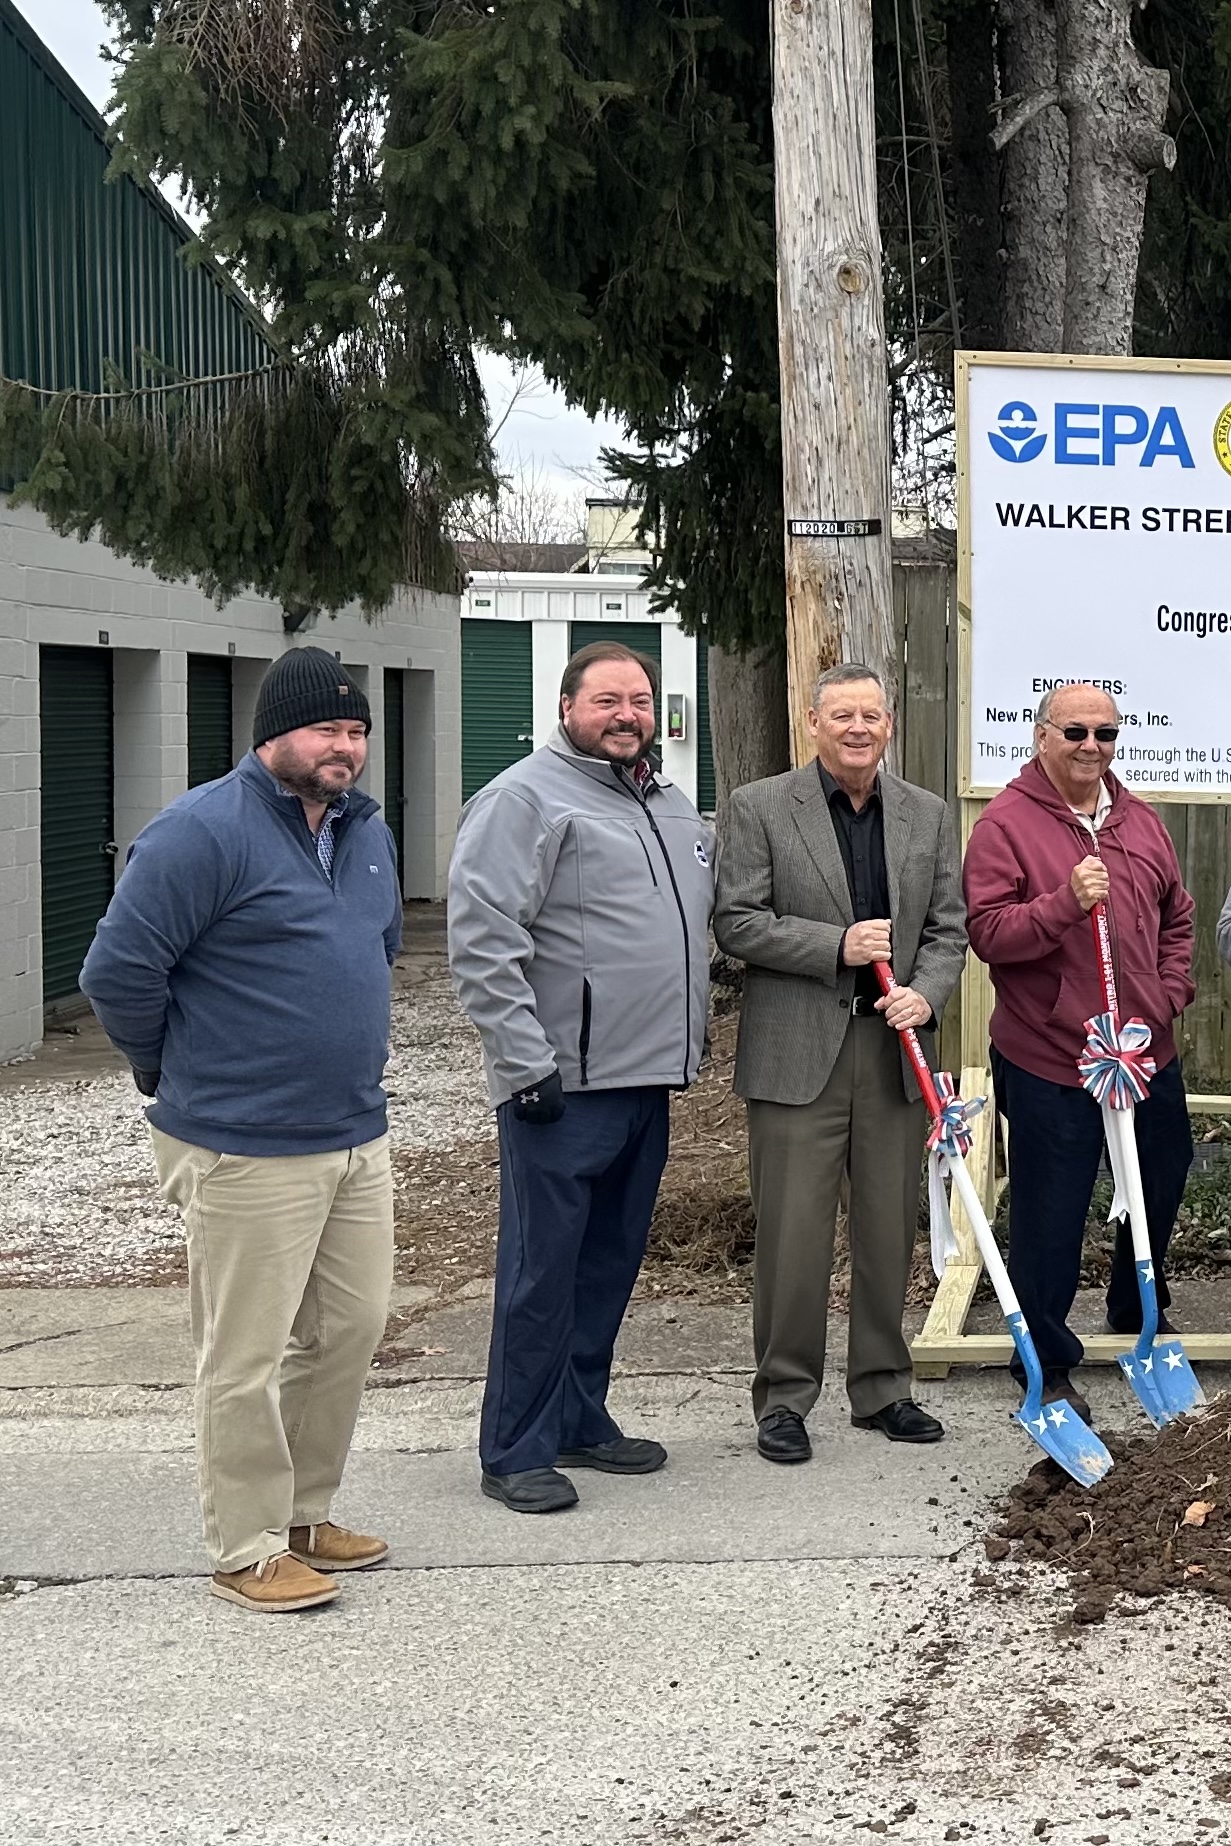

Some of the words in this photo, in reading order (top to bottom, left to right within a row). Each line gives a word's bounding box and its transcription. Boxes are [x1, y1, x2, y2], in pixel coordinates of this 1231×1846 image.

[1054, 403, 1195, 468] EPA
[996, 503, 1130, 530] WALKER
[987, 708, 1018, 722] New
[1147, 711, 1173, 726] Inc.
[977, 742, 1006, 757] This
[1129, 746, 1180, 764] through
[1186, 747, 1206, 762] the
[1126, 768, 1179, 782] secured
[1184, 768, 1211, 783] with
